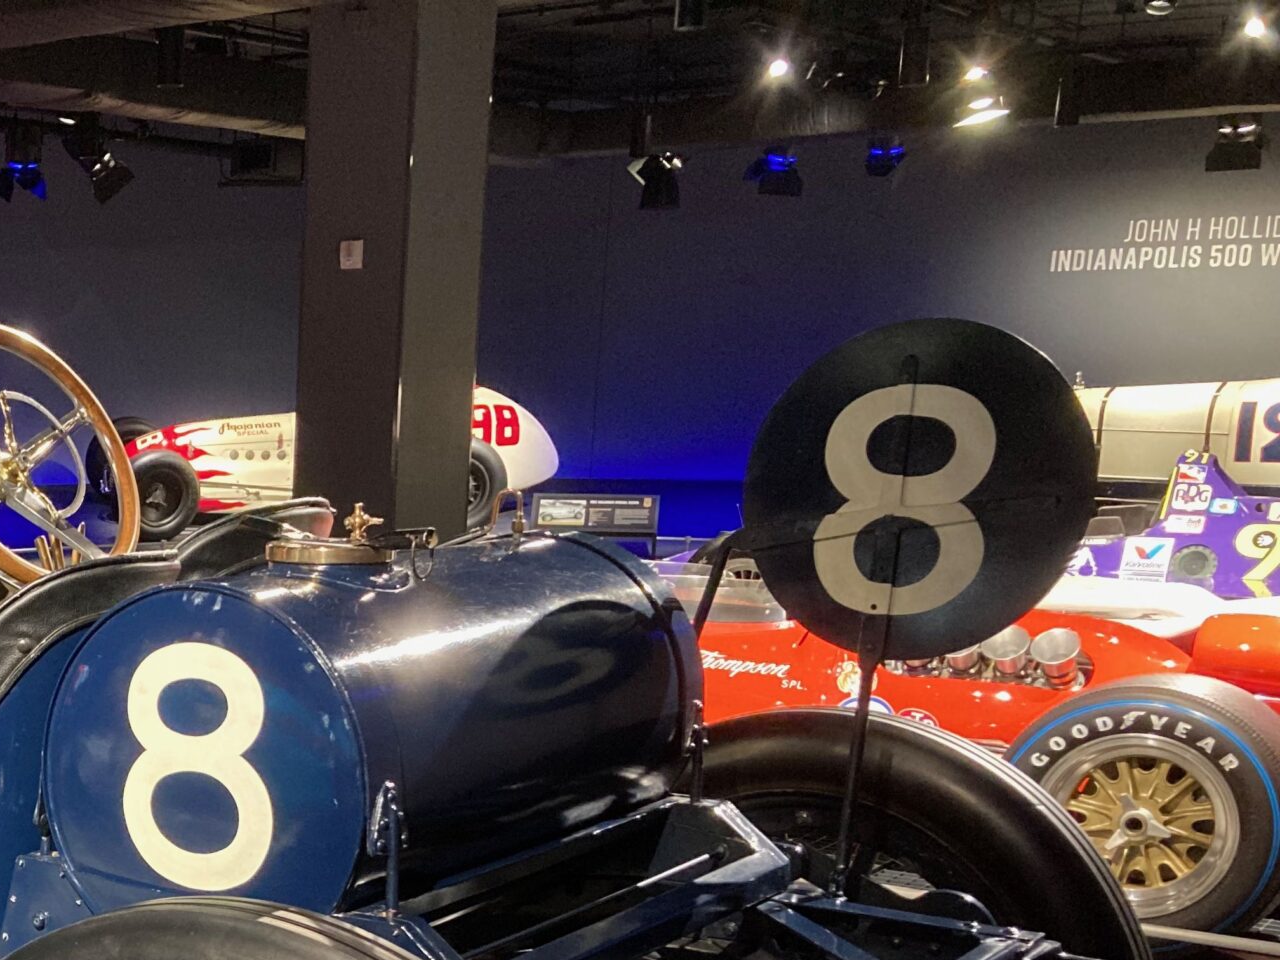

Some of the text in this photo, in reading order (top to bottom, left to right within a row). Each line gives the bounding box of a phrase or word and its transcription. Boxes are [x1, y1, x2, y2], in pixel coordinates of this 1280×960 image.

[1124, 218, 1180, 243] JOHN
[1186, 218, 1201, 241] H
[1049, 244, 1202, 273] INDIANAPOLIS
[1208, 243, 1253, 268] 500
[236, 429, 270, 437] SPECIAL
[472, 404, 521, 447] 98
[1184, 448, 1210, 464] 91
[814, 384, 997, 615] 8
[781, 679, 808, 691] SPL.
[1030, 711, 1241, 772] GOODYEAR
[122, 642, 274, 891] 8
